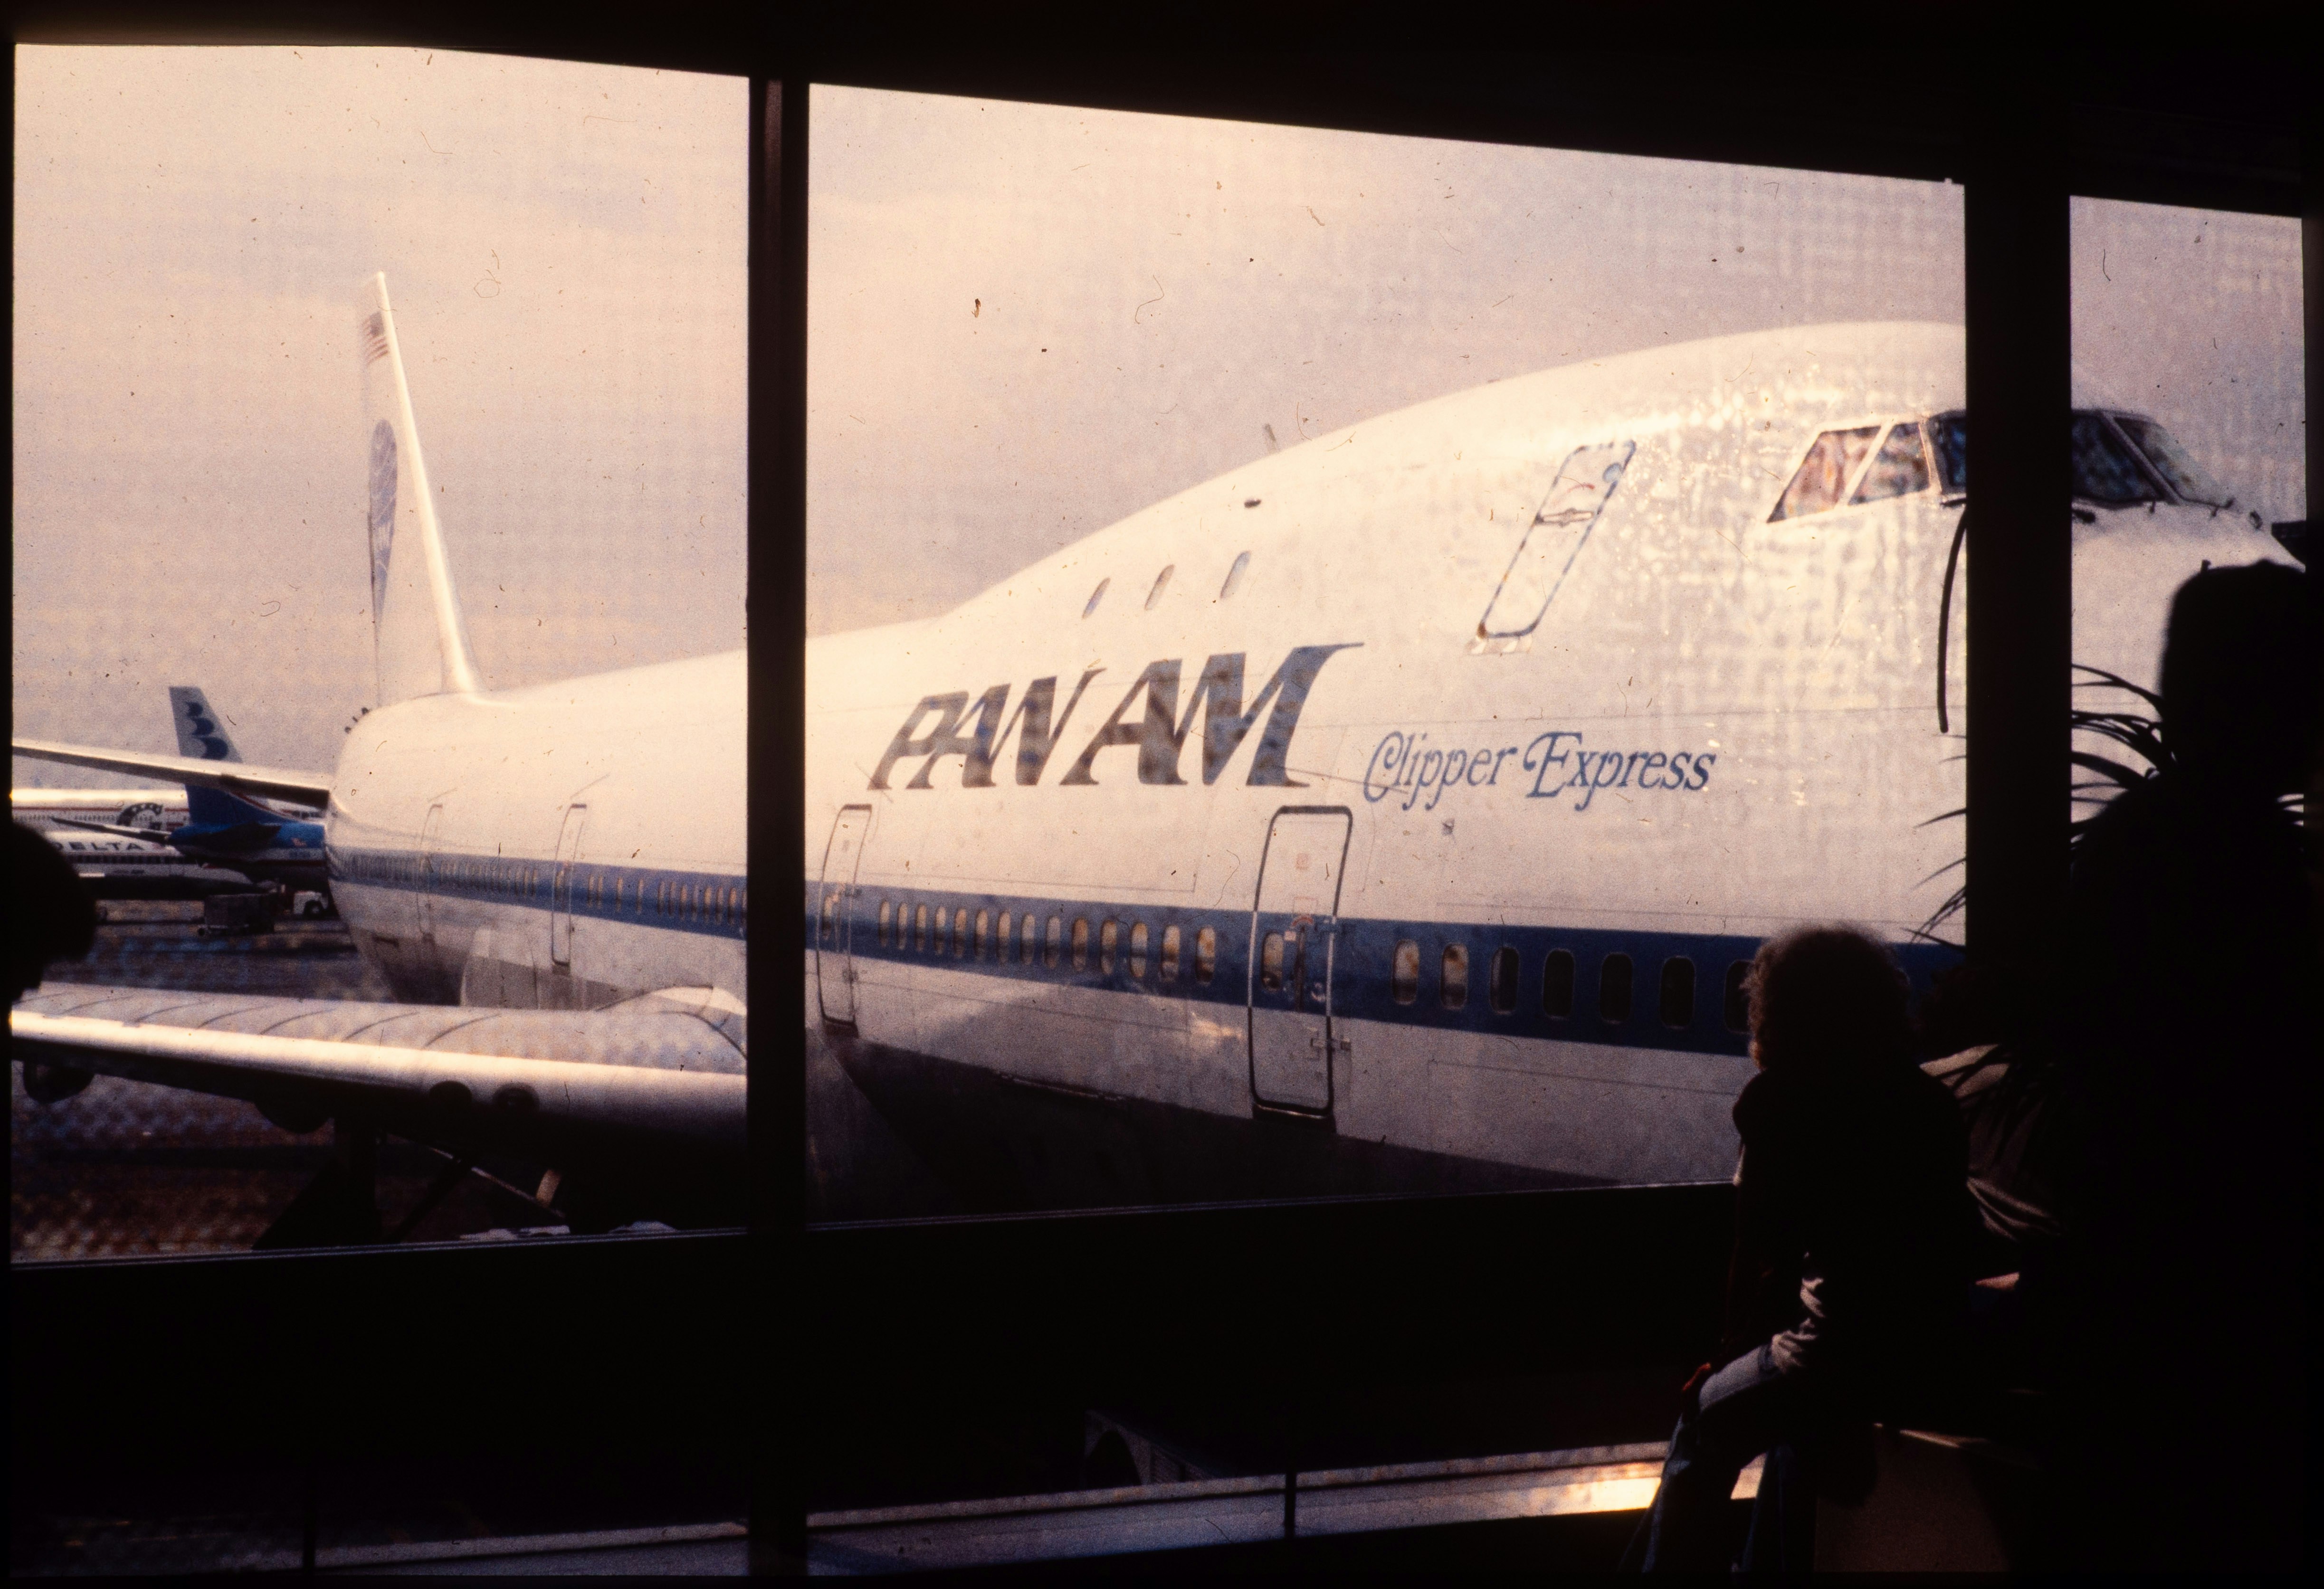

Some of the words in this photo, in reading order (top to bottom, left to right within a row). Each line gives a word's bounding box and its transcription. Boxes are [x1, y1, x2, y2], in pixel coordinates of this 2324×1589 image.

[867, 668, 1106, 790] PAN
[1059, 642, 1364, 788] AM
[1363, 730, 1518, 811] Clipper
[1523, 731, 1716, 811] Express
